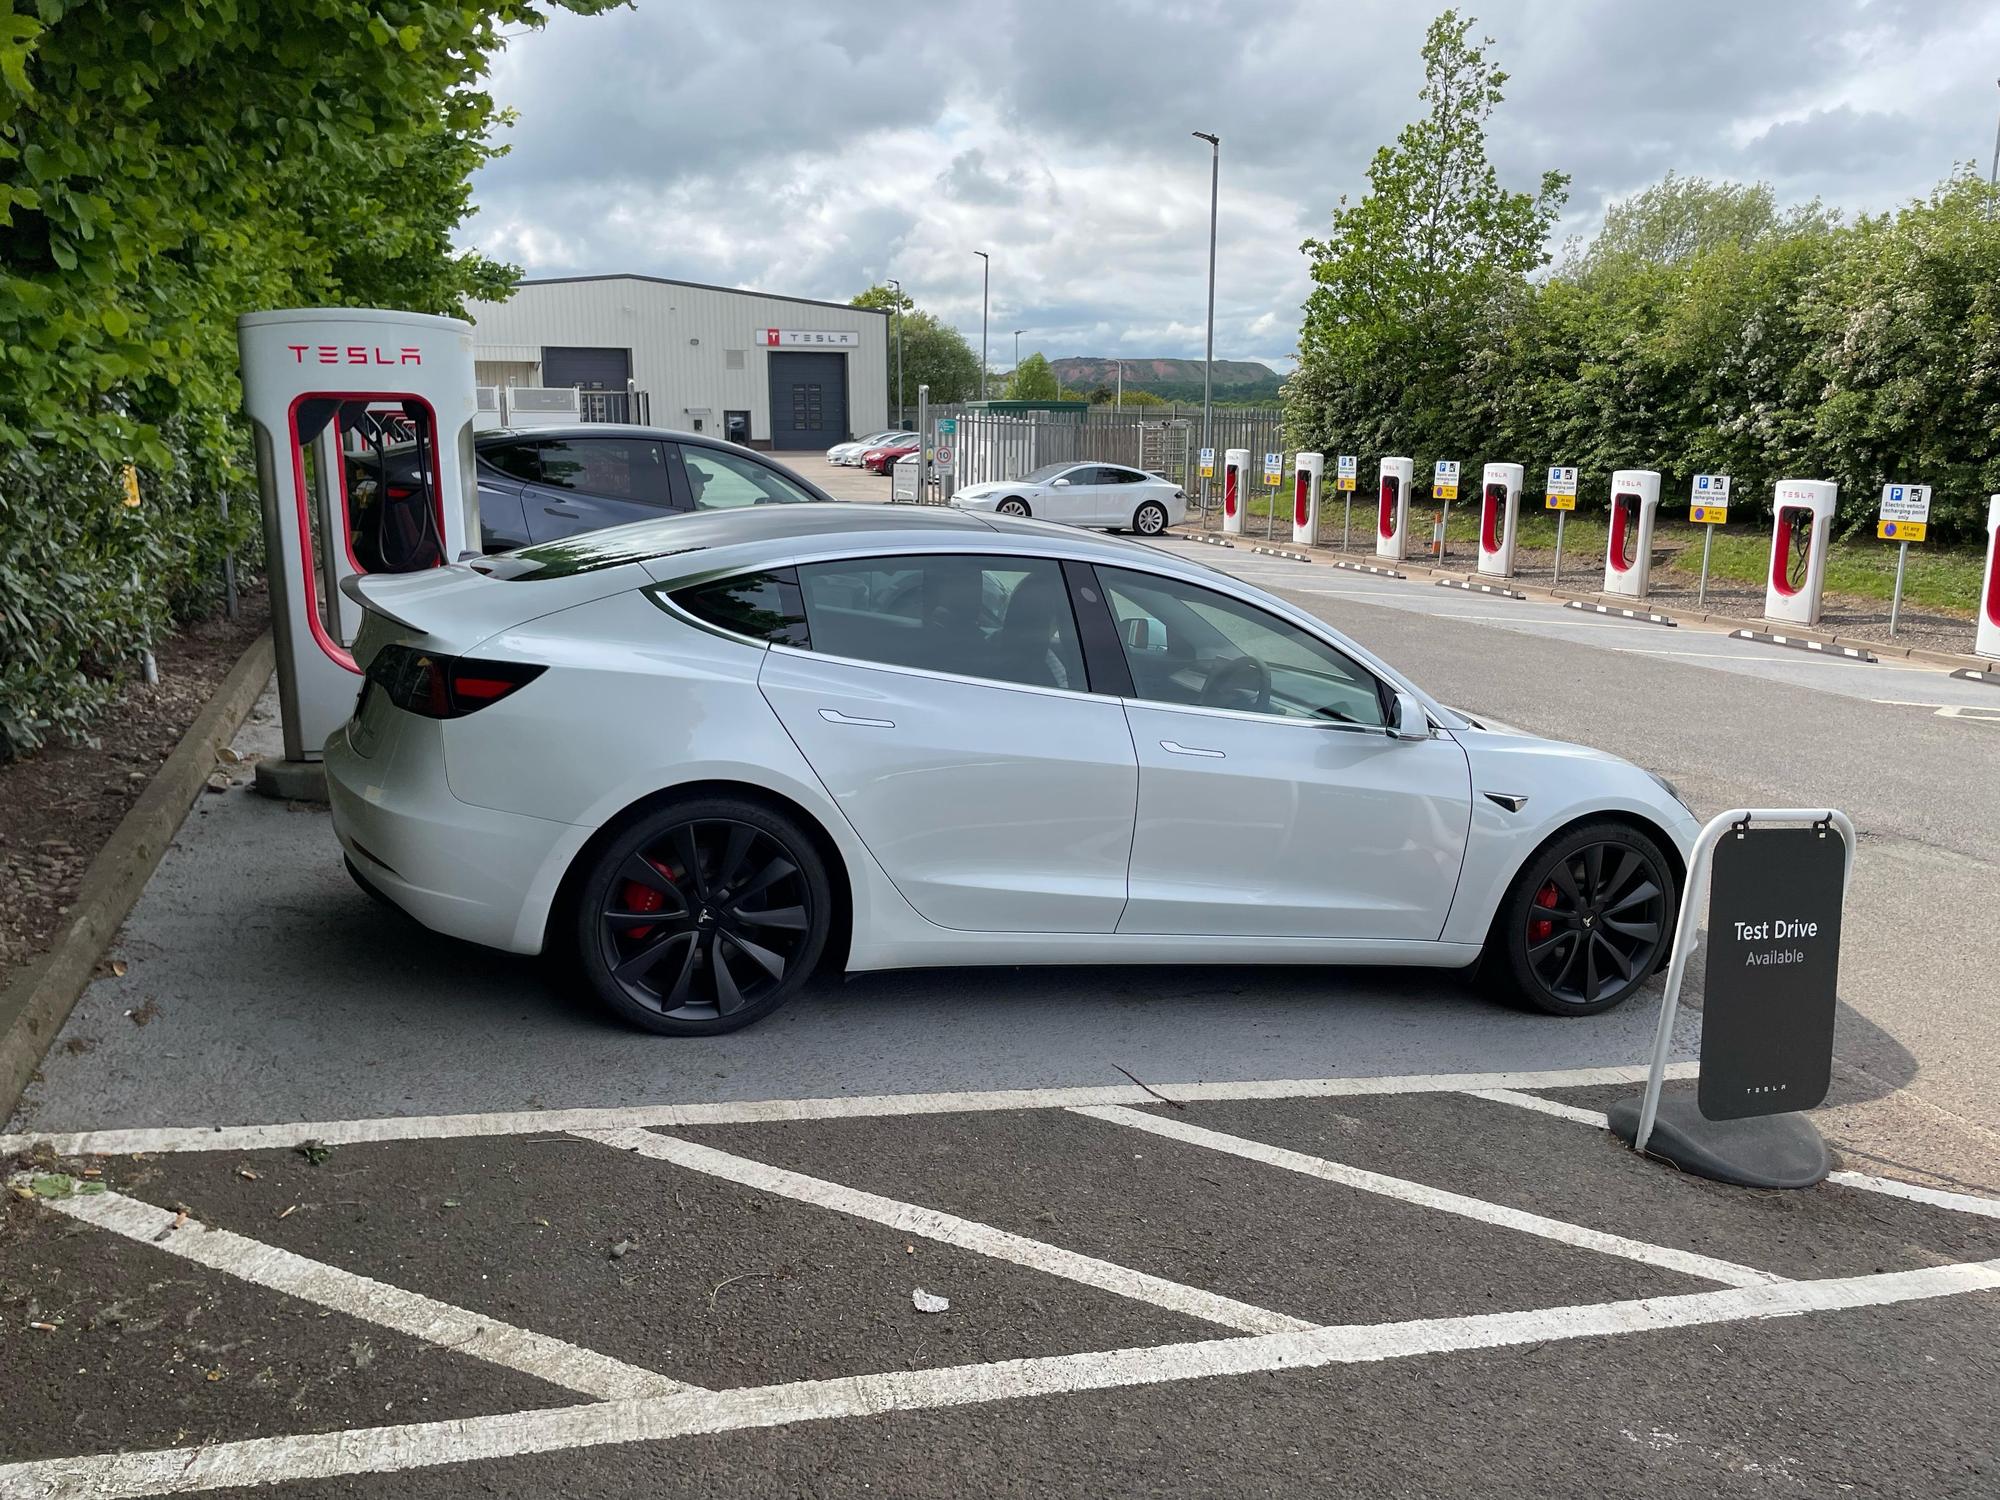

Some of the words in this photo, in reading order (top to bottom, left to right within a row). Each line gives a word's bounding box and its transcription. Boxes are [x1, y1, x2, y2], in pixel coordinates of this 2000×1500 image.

[790, 334, 848, 343] TESLA
[288, 346, 421, 365] TESLA
[1782, 491, 1814, 500] TESLA
[1734, 922, 1769, 940] Test
[1774, 919, 1818, 938] Drive
[1746, 949, 1804, 966] Available
[1746, 1084, 1786, 1094] TESLA
